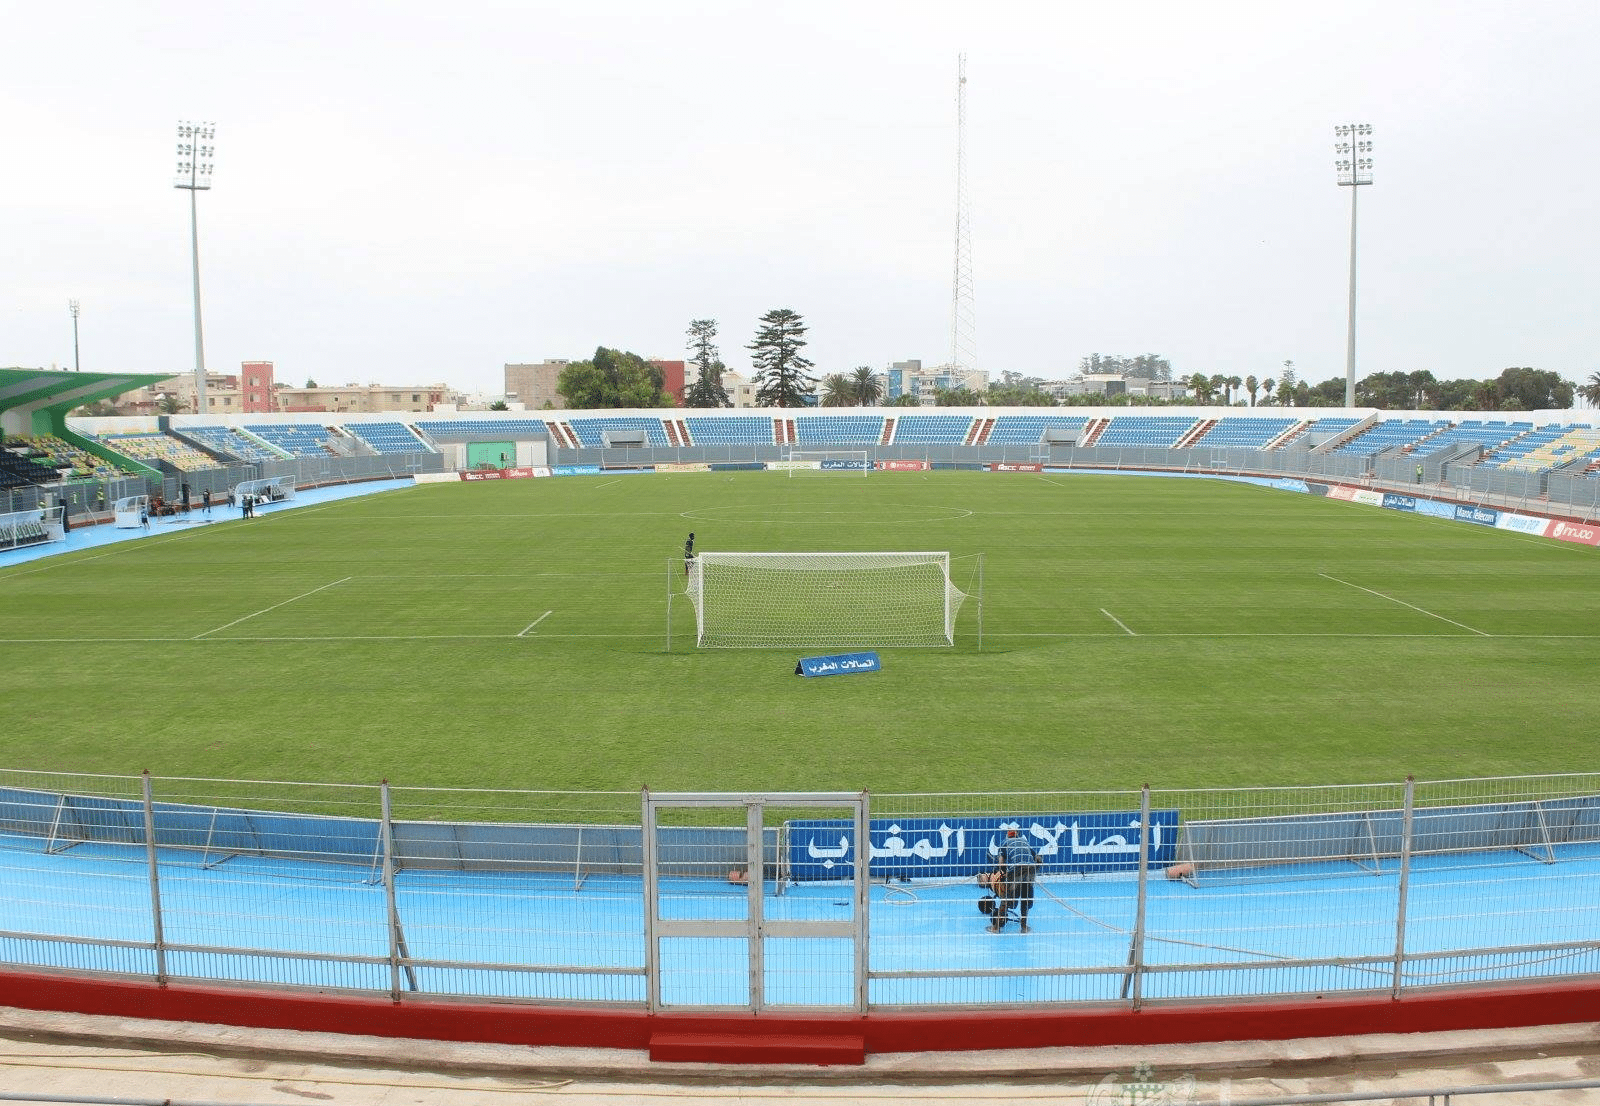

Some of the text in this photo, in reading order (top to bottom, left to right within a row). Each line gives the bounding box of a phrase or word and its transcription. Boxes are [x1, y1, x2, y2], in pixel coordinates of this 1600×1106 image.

[1456, 506, 1494, 522] Maroc Telecom
[808, 659, 875, 673] اتصالات المغرب
